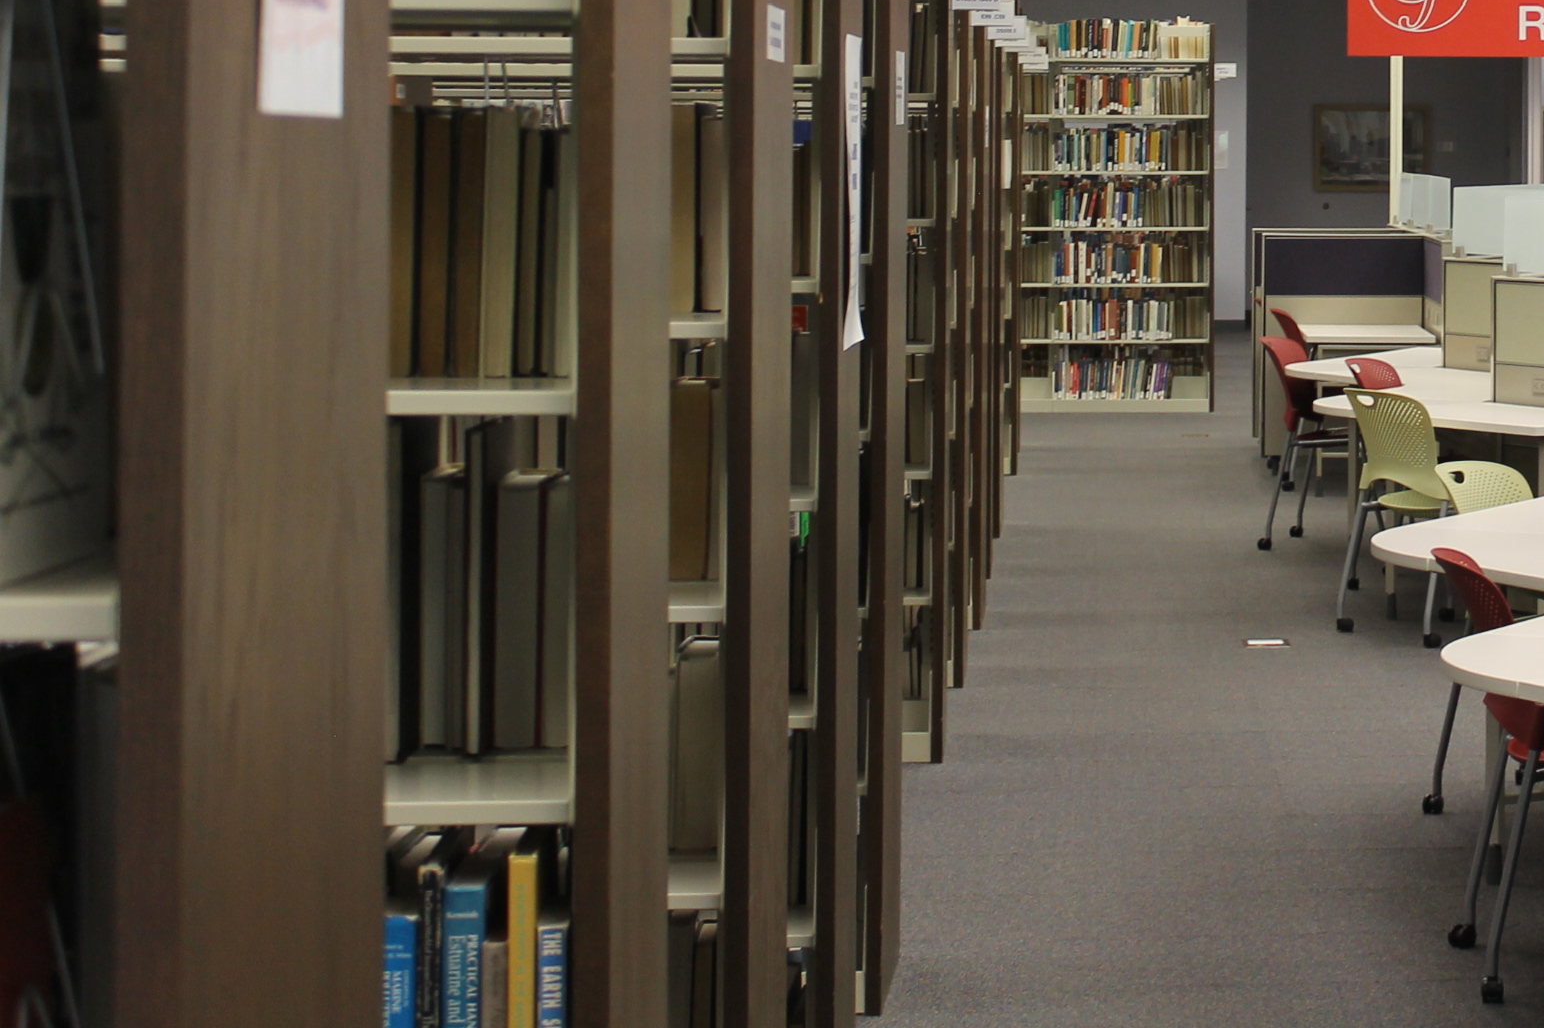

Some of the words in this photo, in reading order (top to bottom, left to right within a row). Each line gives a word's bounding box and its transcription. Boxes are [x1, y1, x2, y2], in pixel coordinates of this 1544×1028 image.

[447, 935, 466, 997] Estuarine
[466, 934, 479, 998] PRACTICAL
[542, 933, 563, 956] THE
[542, 965, 563, 1009] EARTH
[447, 999, 466, 1024] and
